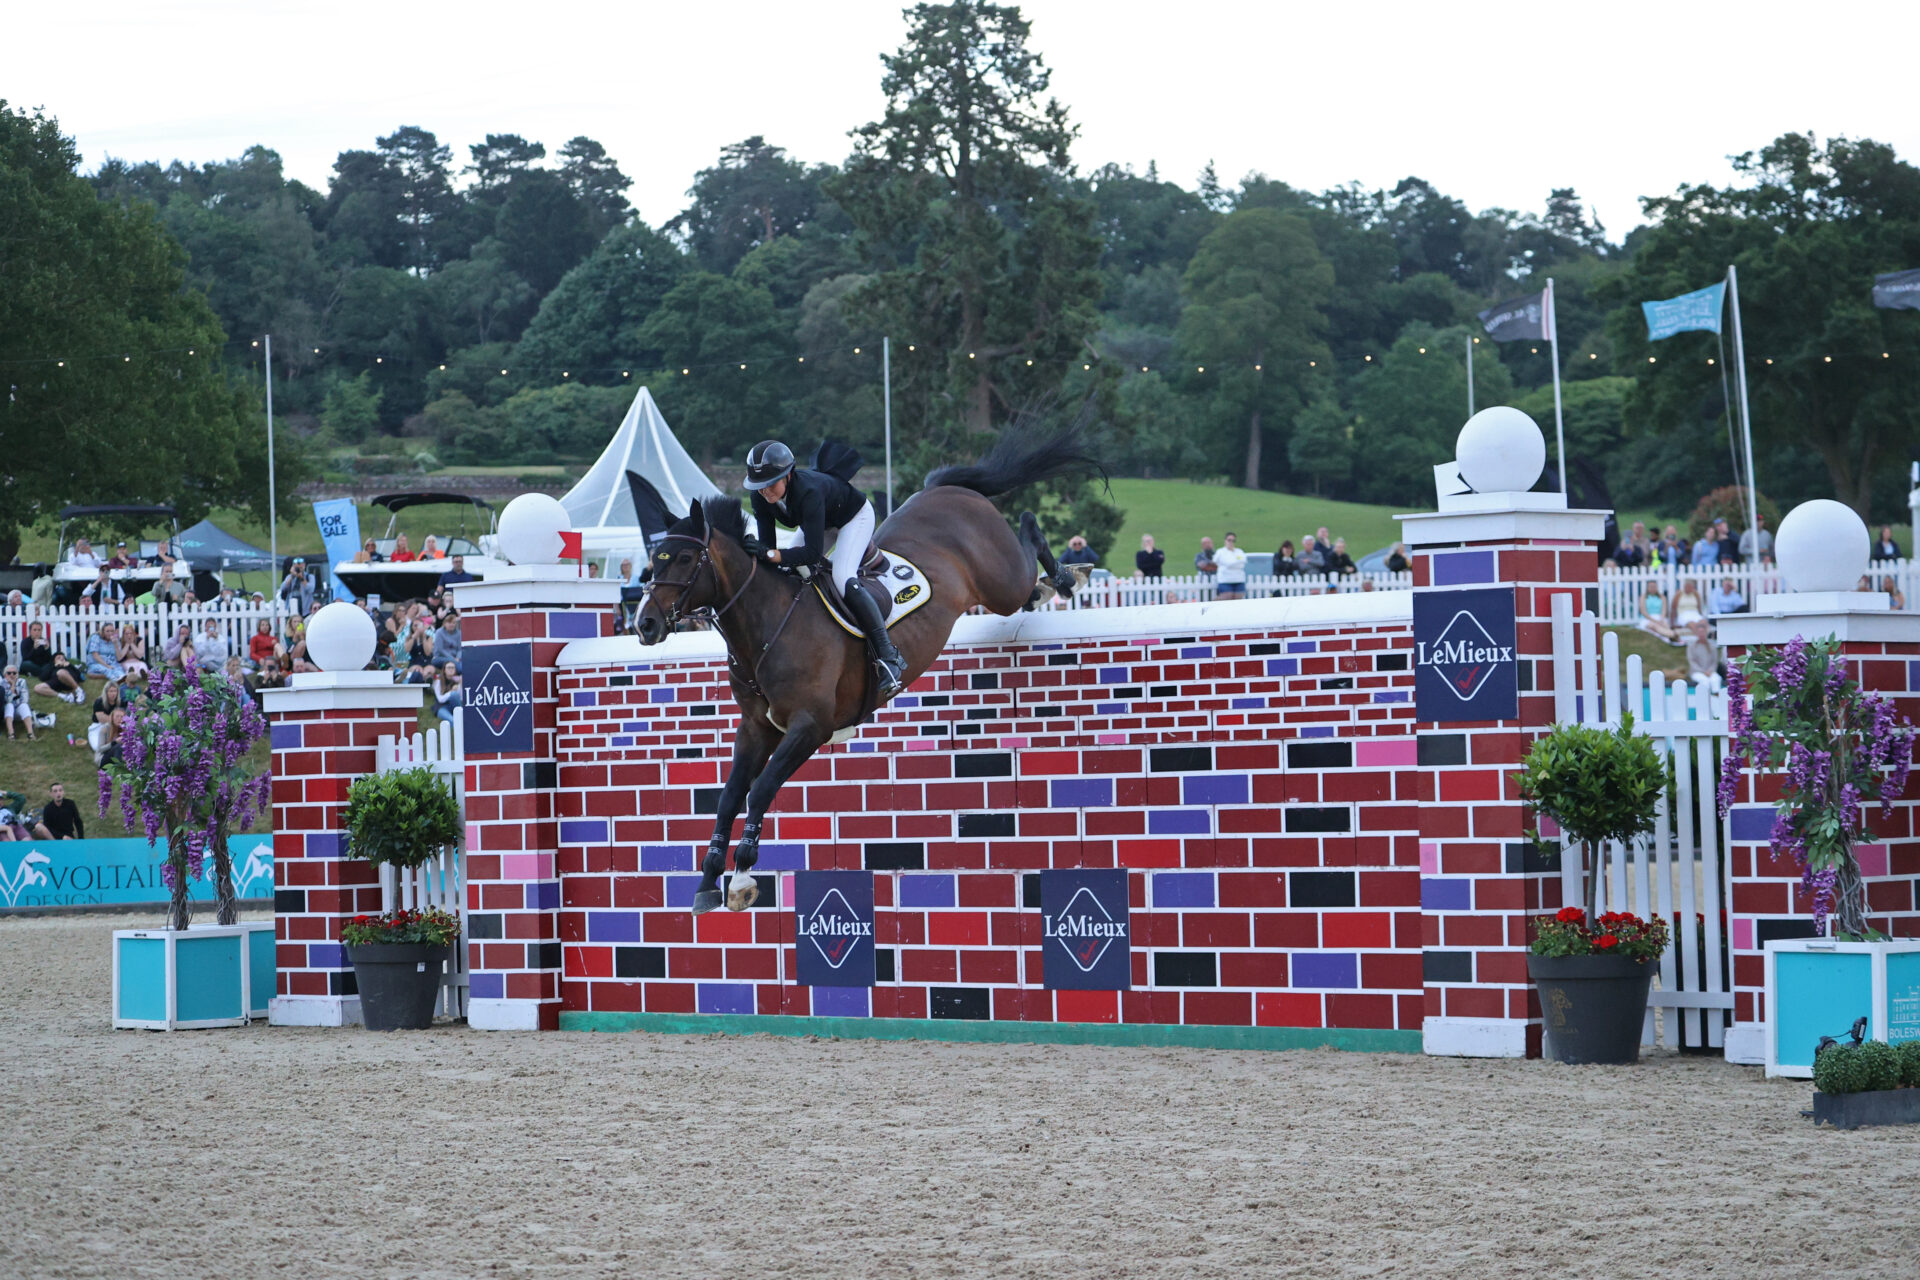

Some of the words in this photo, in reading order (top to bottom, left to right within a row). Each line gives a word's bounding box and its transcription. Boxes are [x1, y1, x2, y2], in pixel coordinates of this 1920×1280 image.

[320, 515, 342, 527] FOR
[322, 525, 348, 538] SALE
[1417, 640, 1512, 665] LeMieux
[464, 686, 530, 707] LeMieux
[48, 864, 164, 891] VOLTAI
[798, 914, 872, 936] LeMieux
[1044, 915, 1126, 937] LeMieux
